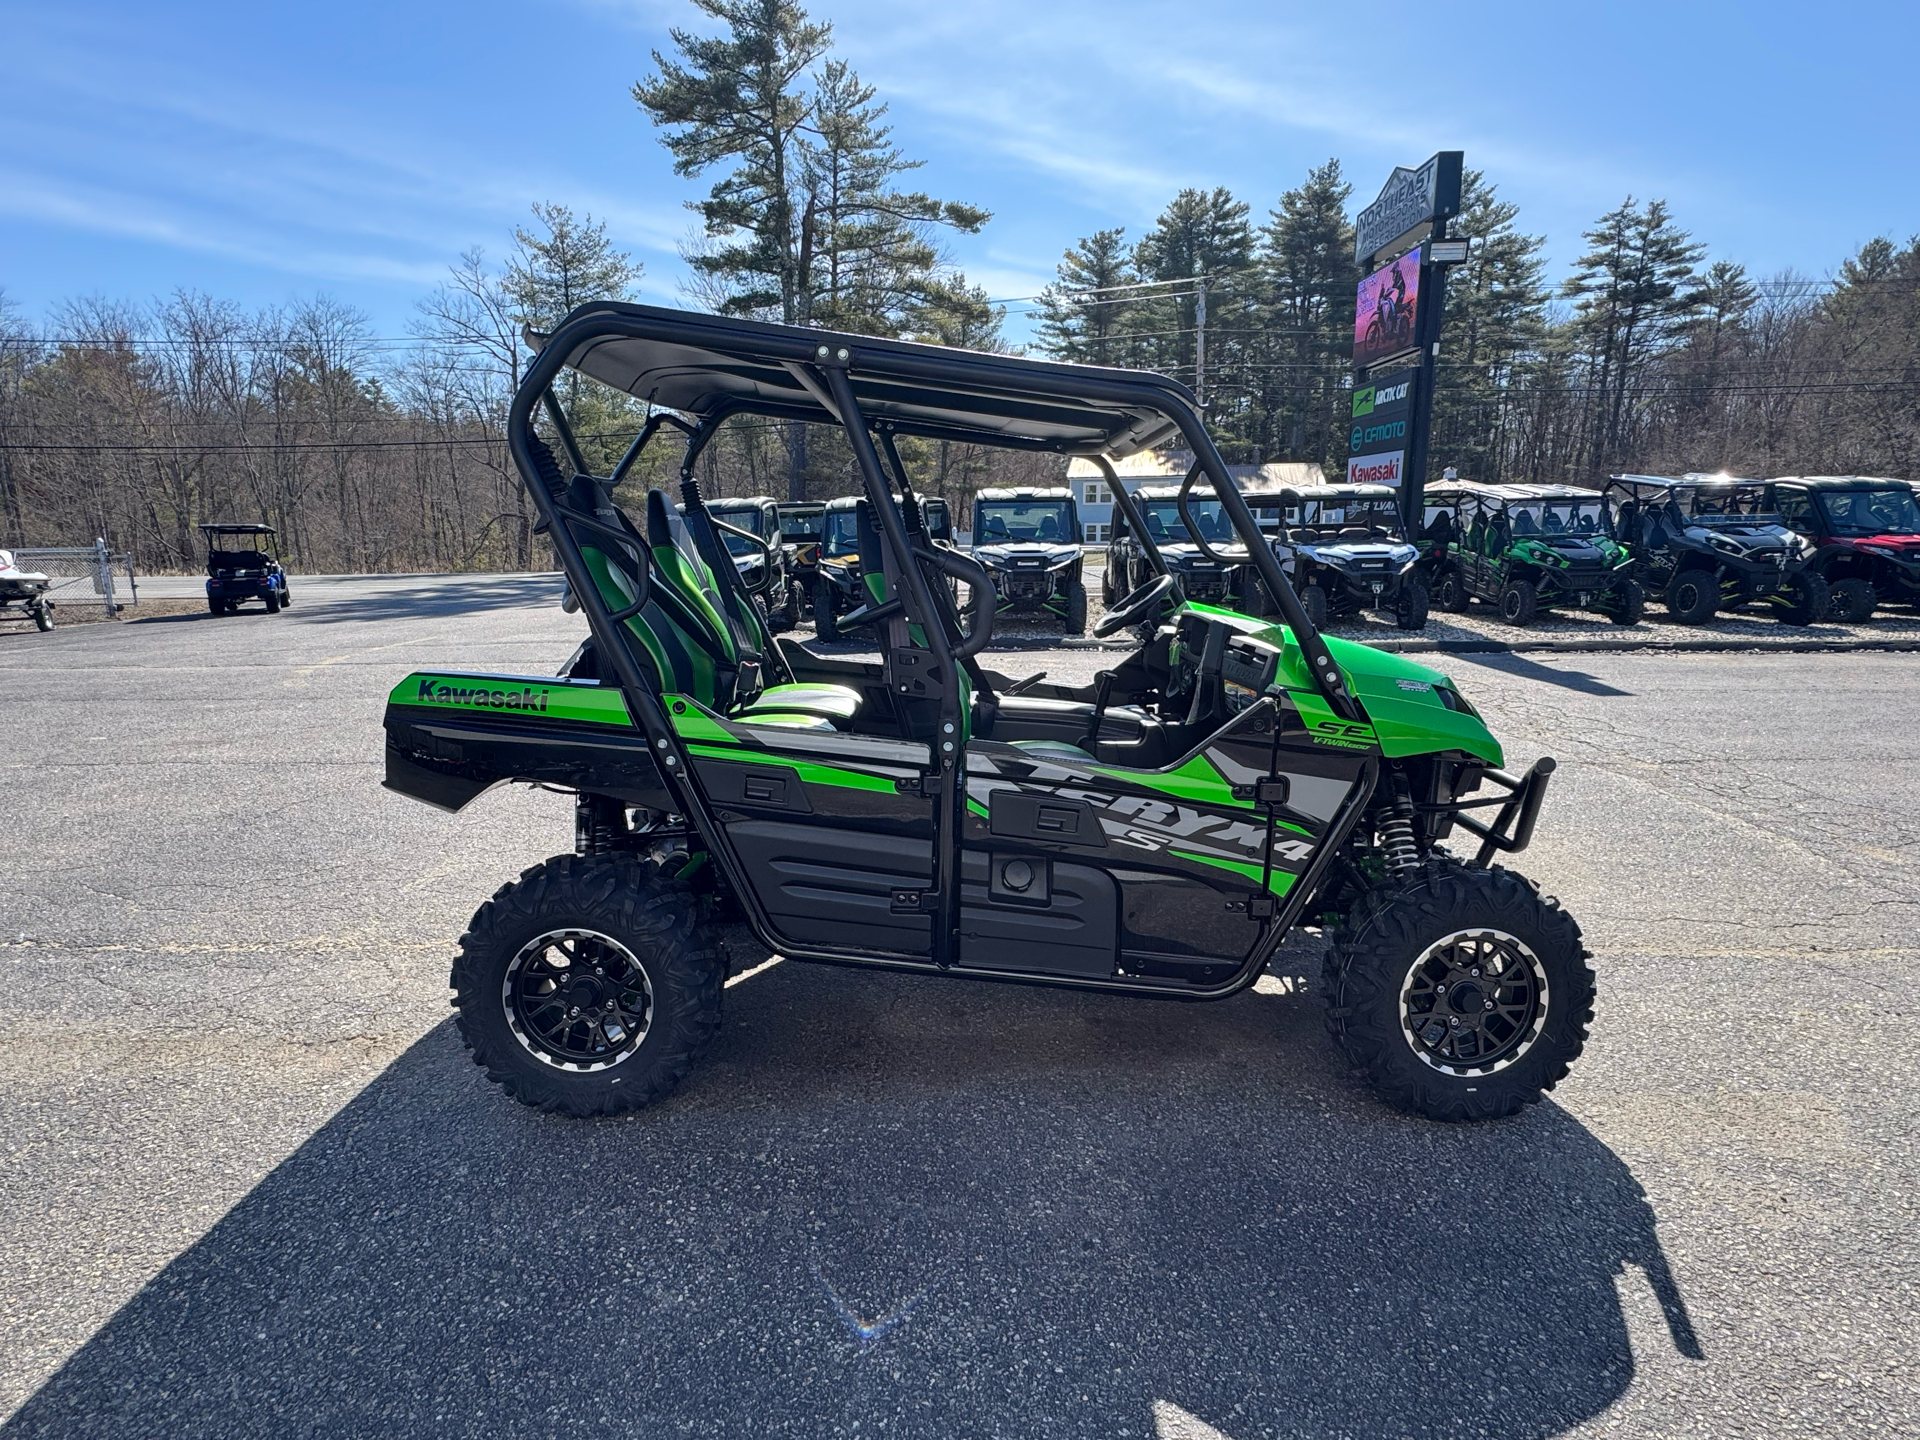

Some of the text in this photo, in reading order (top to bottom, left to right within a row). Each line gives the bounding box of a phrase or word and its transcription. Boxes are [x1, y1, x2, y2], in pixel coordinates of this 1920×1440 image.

[1358, 162, 1435, 232] NORTHEAST
[1362, 189, 1427, 245] MOTORSPORTS
[1375, 382, 1410, 406] ARCTIC CAT
[1364, 420, 1406, 443] CFMOTO
[1350, 457, 1400, 483] Kawasaki
[418, 679, 550, 712] Kawasaki
[1317, 721, 1371, 736] SE
[1111, 831, 1170, 852] S
